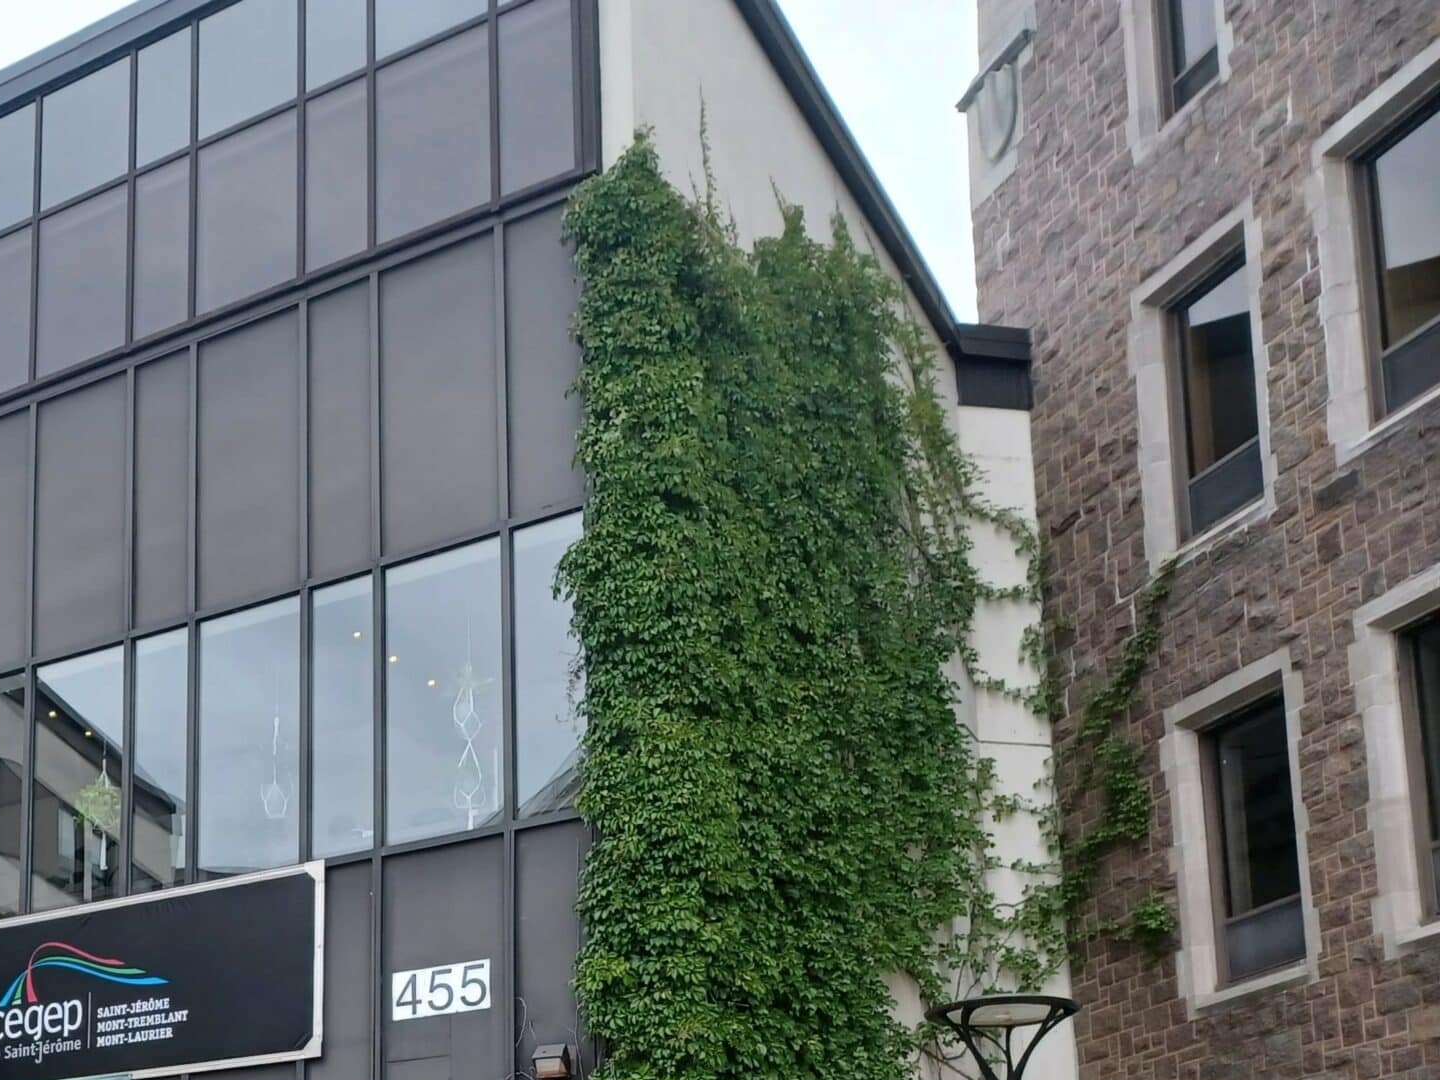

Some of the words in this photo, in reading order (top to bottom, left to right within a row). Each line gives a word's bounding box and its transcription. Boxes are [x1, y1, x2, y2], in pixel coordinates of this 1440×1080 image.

[396, 963, 487, 1015] 455
[97, 997, 170, 1019] SAINT-JÉRÔME
[96, 1009, 189, 1033] MONT-TREMBLANT
[96, 1026, 173, 1048] MONT-LAURIER
